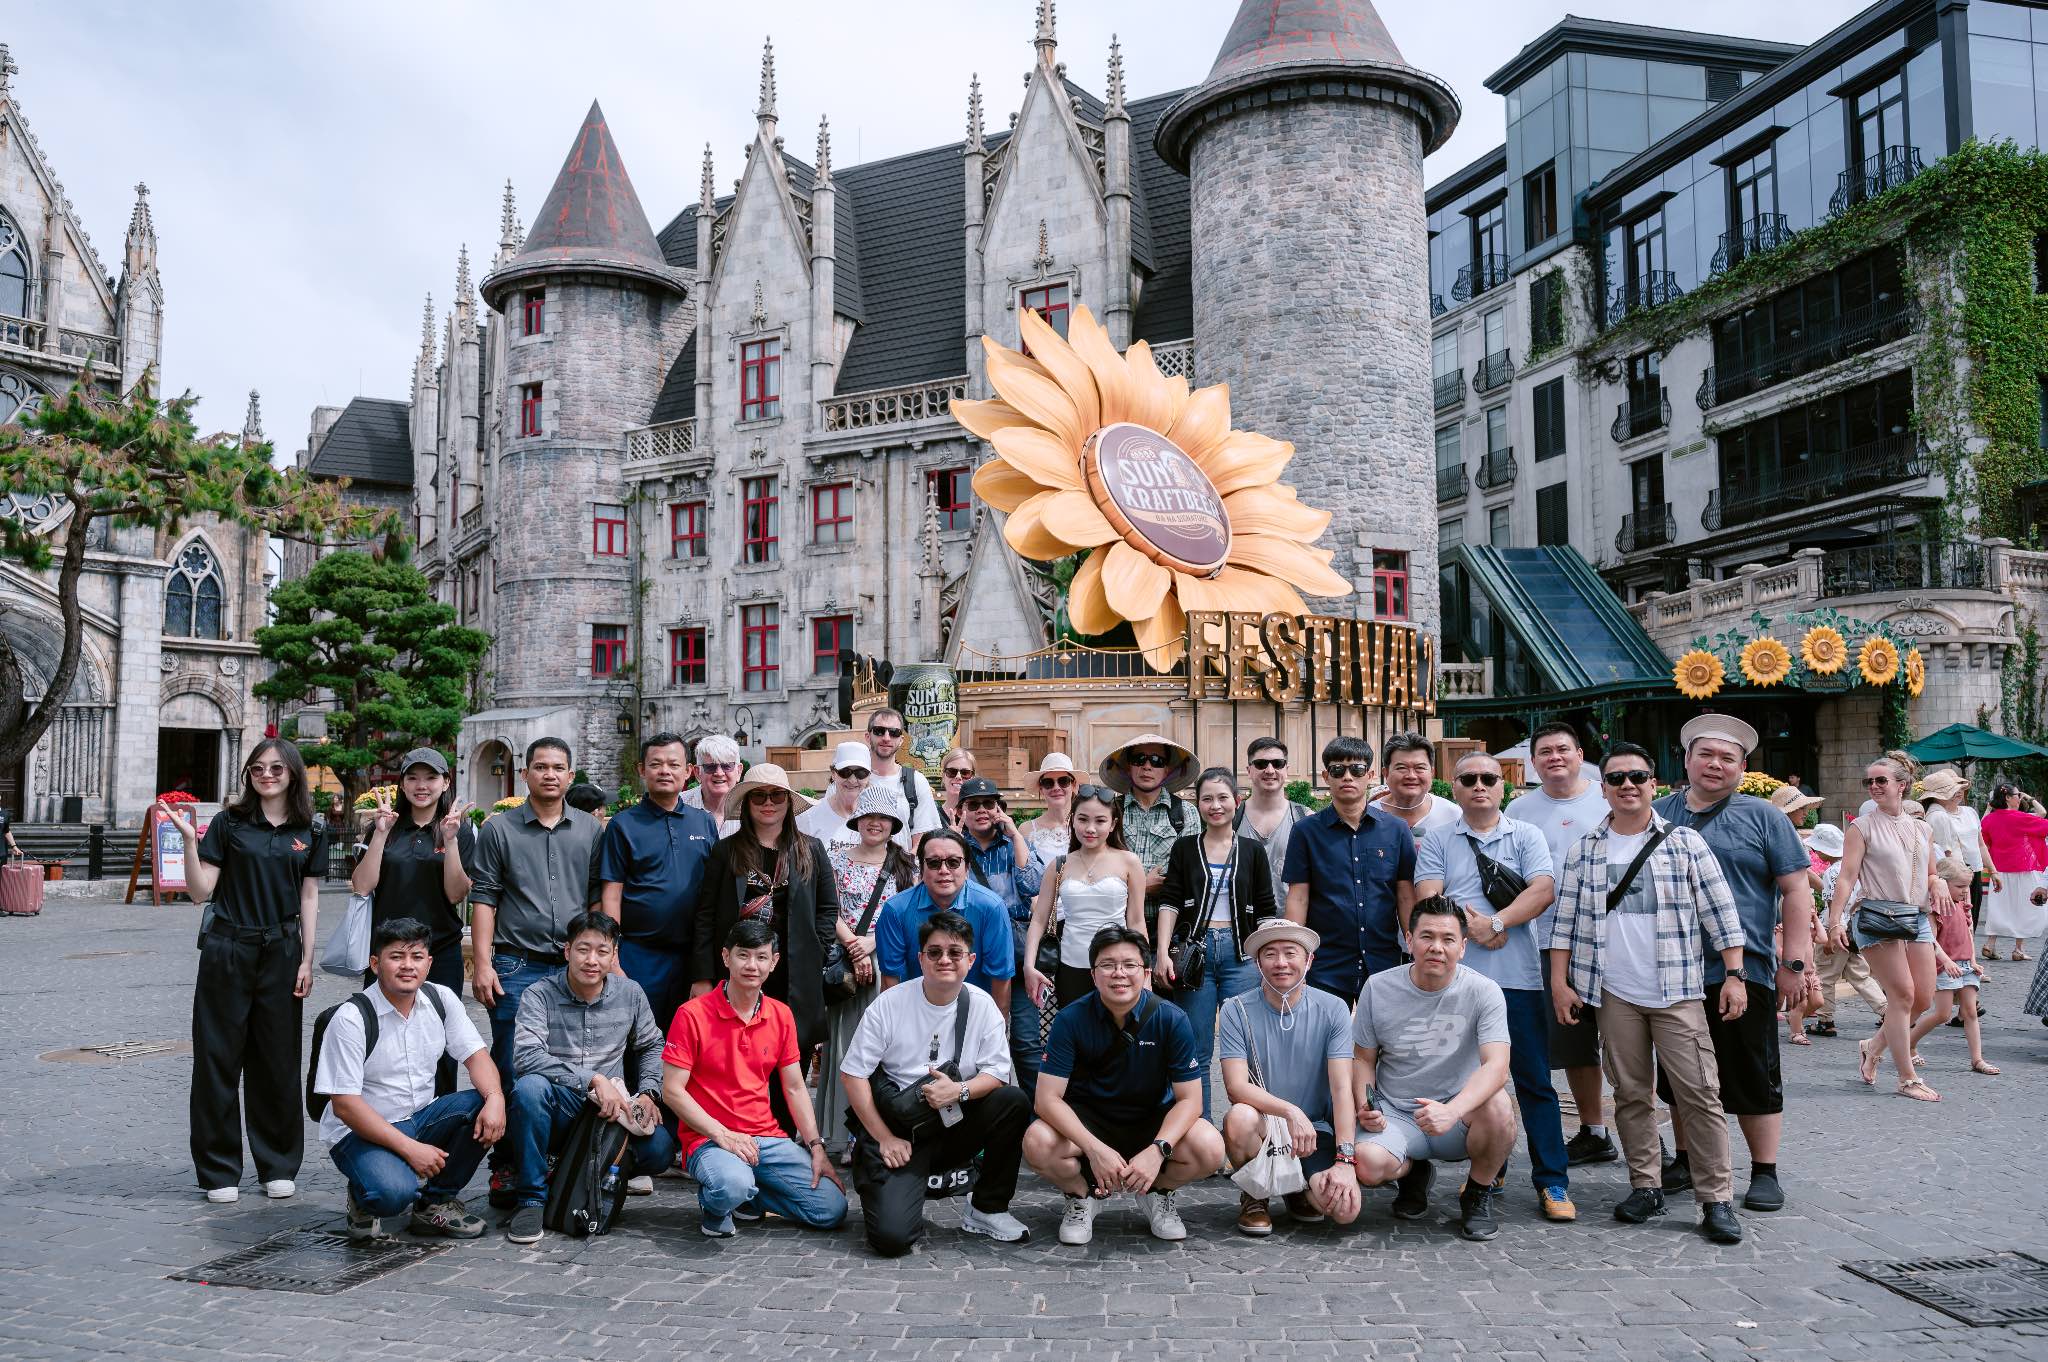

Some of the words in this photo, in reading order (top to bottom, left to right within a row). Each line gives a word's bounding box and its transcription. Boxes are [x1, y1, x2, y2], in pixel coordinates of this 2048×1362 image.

[1187, 611, 1425, 712] FESTIVAL
[909, 688, 937, 705] SUN
[905, 702, 957, 717] KRAFTBEER
